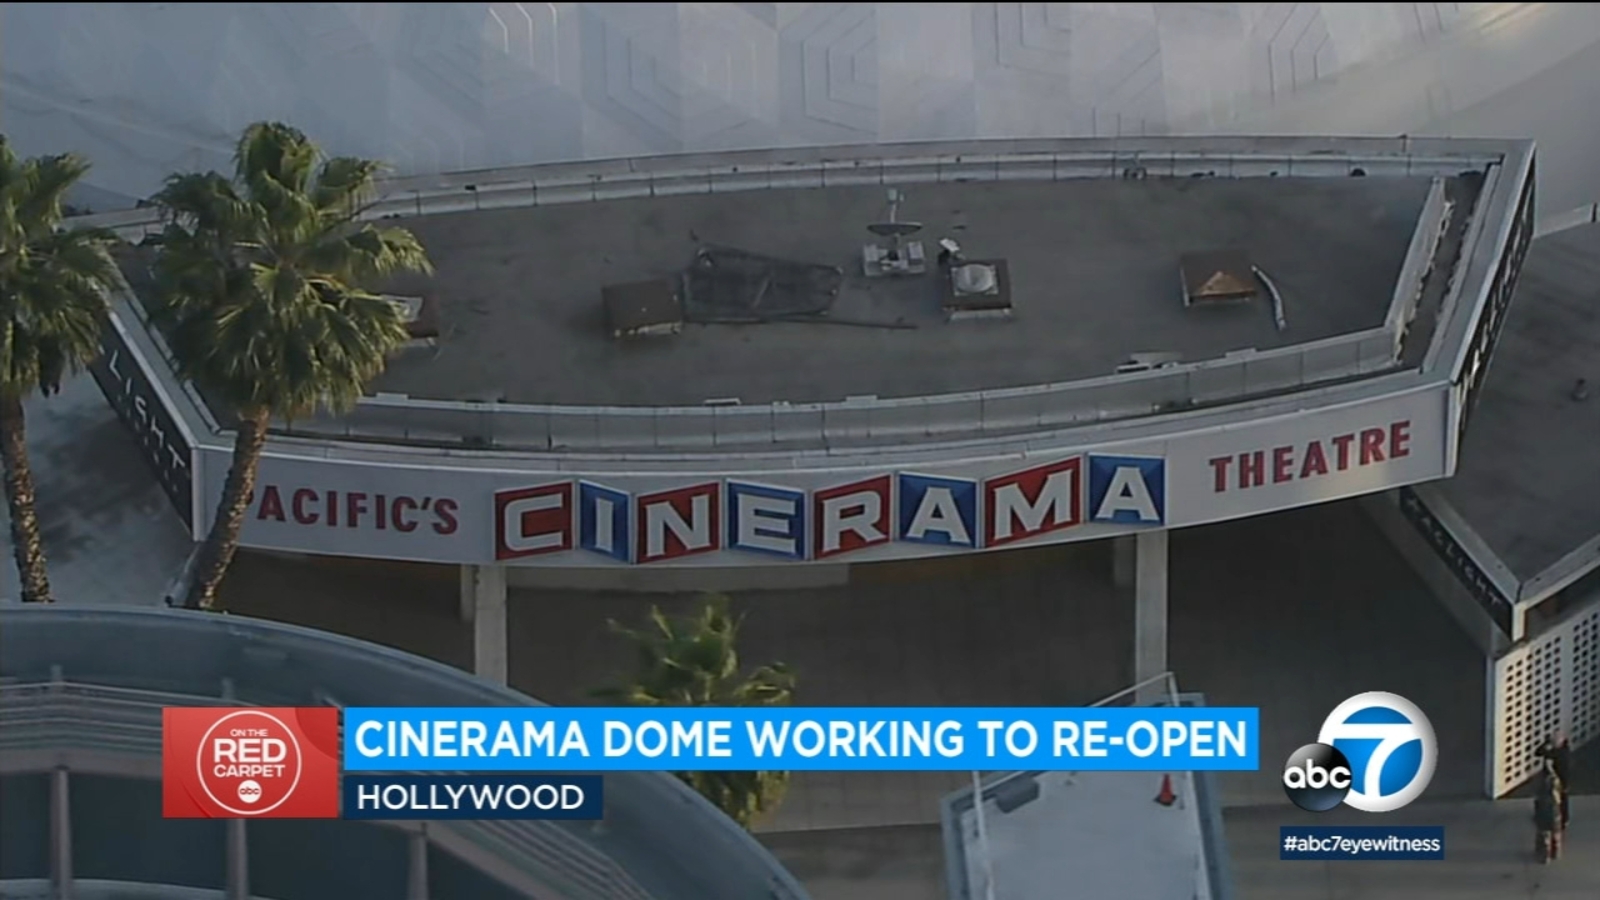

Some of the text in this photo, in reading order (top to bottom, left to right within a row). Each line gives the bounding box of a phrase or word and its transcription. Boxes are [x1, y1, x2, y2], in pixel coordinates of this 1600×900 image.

[99, 345, 185, 469] LIGHT
[252, 420, 1411, 559] ACIFIC'S CINERAMA THEATRE
